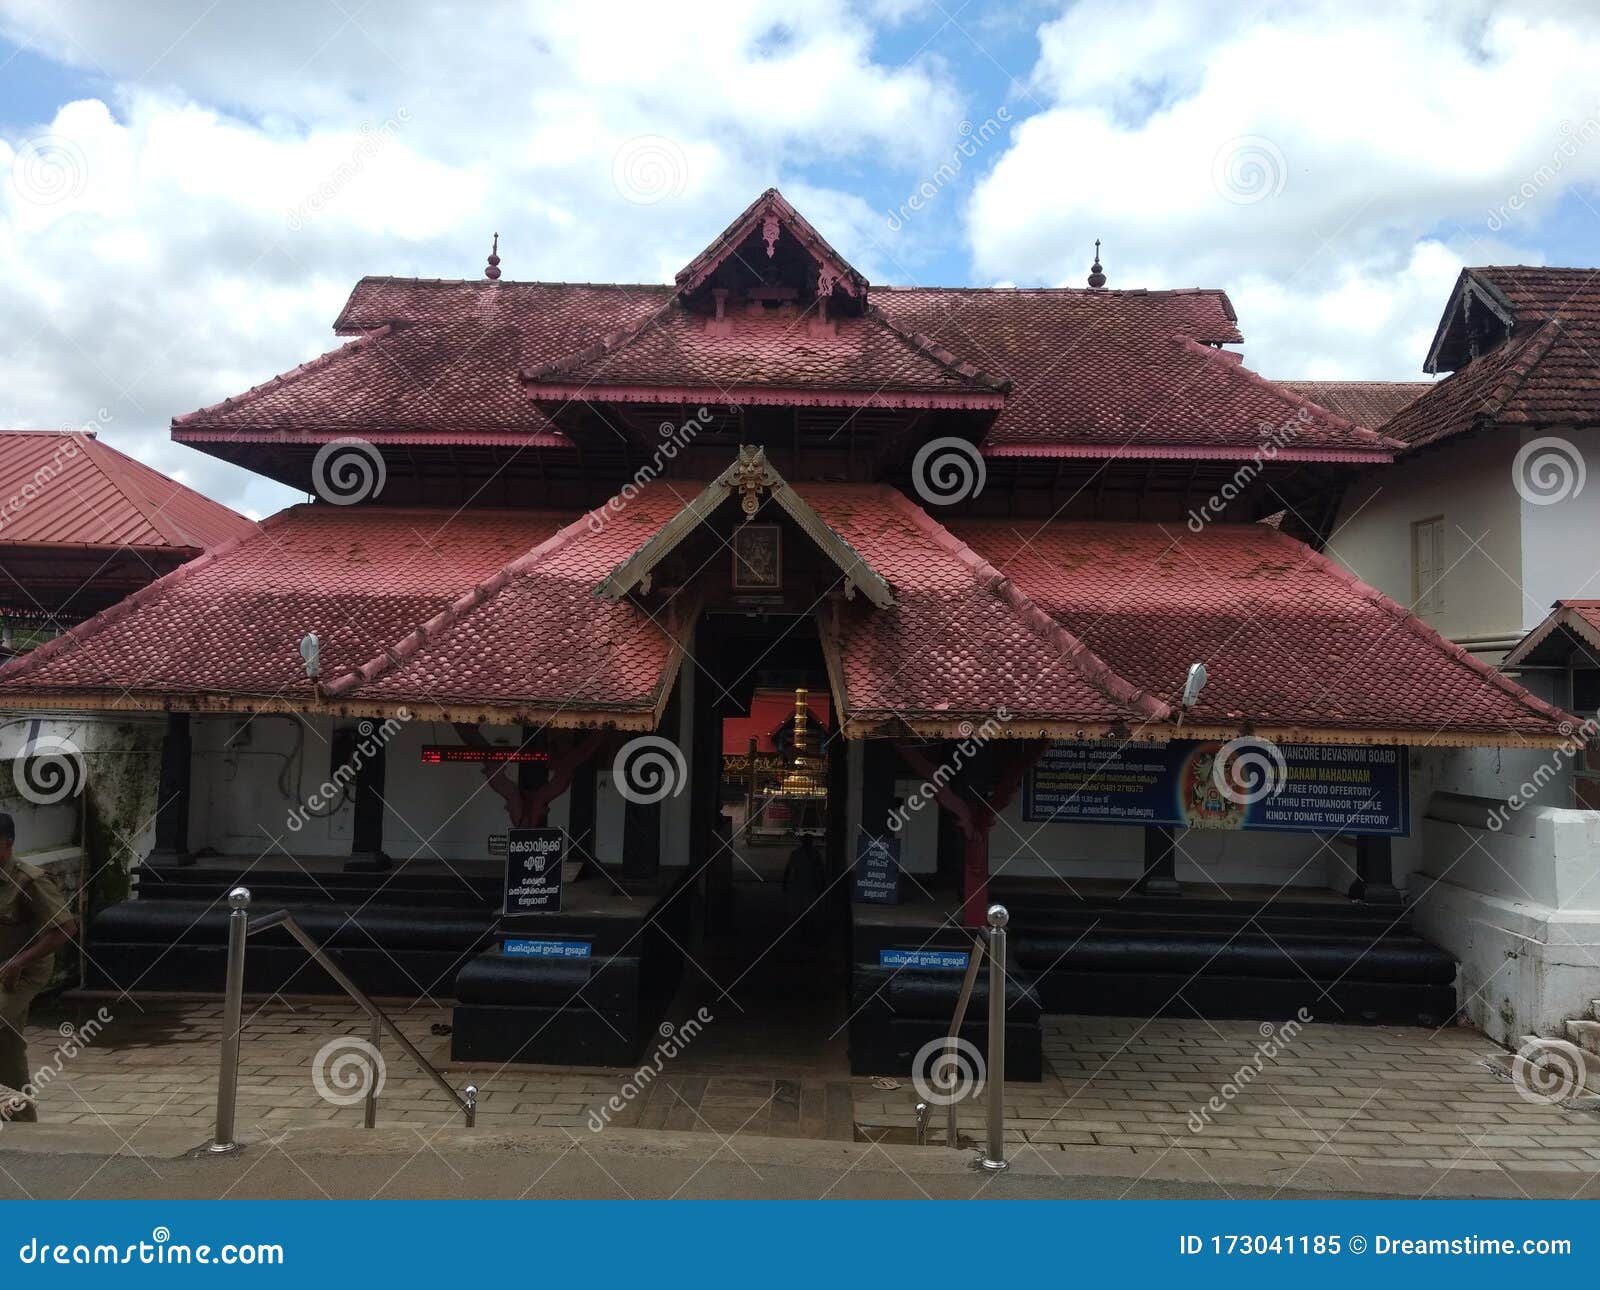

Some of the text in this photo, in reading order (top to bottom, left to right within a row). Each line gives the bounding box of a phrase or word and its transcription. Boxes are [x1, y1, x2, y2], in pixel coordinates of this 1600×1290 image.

[1322, 748, 1368, 763] DEVASWOM
[1369, 749, 1397, 764] BOARD
[1319, 768, 1371, 783] MAHADANAM
[1289, 784, 1307, 794] FREE
[1309, 785, 1328, 795] FOOD
[1330, 786, 1373, 797] OFFERTORY
[1266, 798, 1382, 811] AT THIRU ETTUMANOOR TEMPLE
[1266, 810, 1390, 825] KINDLY DONATE YOUR OFFERTORY
